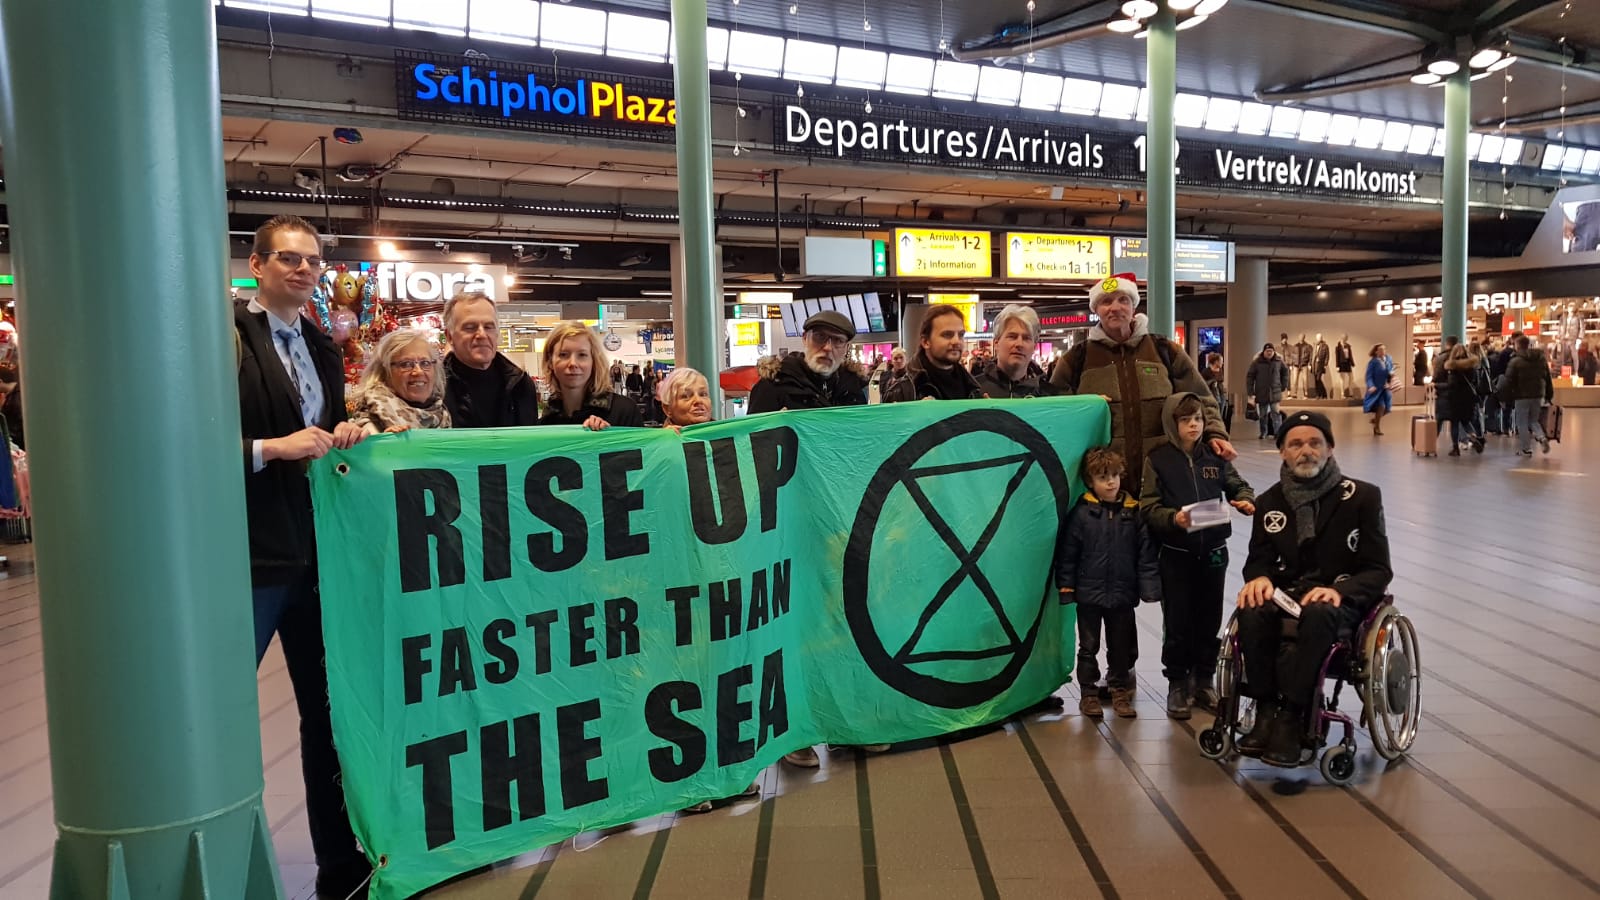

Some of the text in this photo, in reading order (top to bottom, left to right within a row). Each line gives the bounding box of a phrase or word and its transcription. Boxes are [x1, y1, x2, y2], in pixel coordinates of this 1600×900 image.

[413, 63, 586, 117] Schiphol
[929, 232, 960, 241] Arrivals
[962, 236, 981, 250] 1-2
[1036, 236, 1093, 254] Departures 1-2
[930, 260, 977, 269] Information
[1085, 261, 1107, 275] 1-16
[1472, 291, 1533, 311] RAW
[393, 426, 799, 593] RISE UP
[402, 558, 792, 705] FASTER THAN
[405, 647, 790, 851] THE SEA
